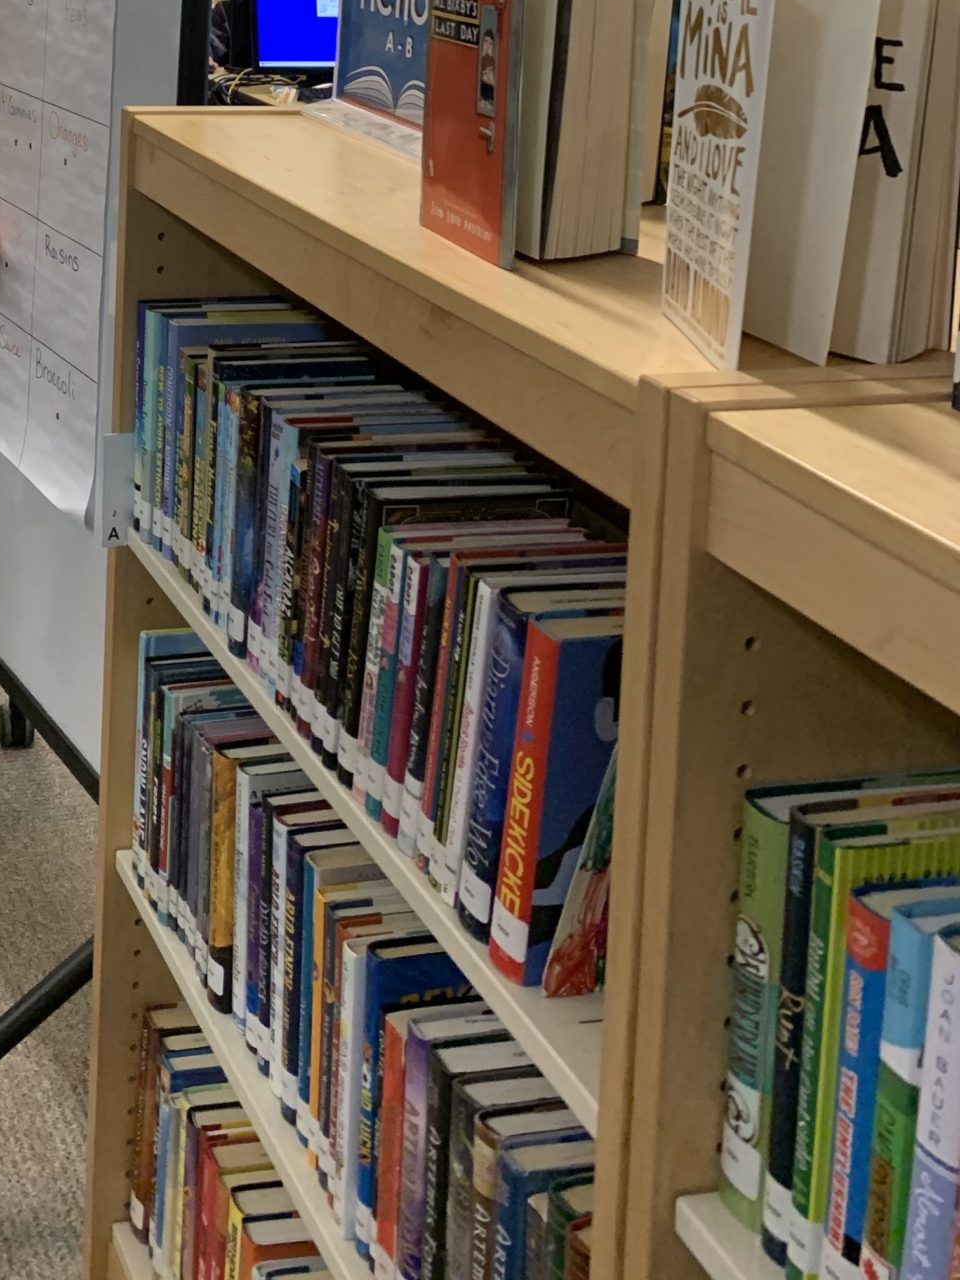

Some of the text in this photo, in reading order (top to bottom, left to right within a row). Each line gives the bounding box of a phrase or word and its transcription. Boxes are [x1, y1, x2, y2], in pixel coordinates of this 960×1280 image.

[435, 19, 478, 42] LAST DAY
[874, 36, 905, 92] E
[48, 111, 88, 157] Oranges
[674, 124, 698, 166] AND
[705, 139, 746, 197] LOVE
[858, 104, 904, 178] A
[35, 347, 76, 400] Broccoli
[164, 365, 173, 426] CONFUSION
[155, 414, 163, 448] AVOID
[107, 526, 120, 541] A
[112, 509, 117, 518] J
[280, 544, 294, 618] ALCATRAZ
[388, 553, 396, 594] CABOT
[405, 565, 413, 607] CABOT
[481, 649, 512, 731] Diary
[526, 655, 541, 728] ANDERSON
[141, 738, 149, 785] SNOW
[498, 750, 535, 919] SIDEKICKE
[270, 912, 279, 966] FINCH
[282, 887, 295, 990] ARLO FINCH
[938, 972, 956, 1044] JOAN
